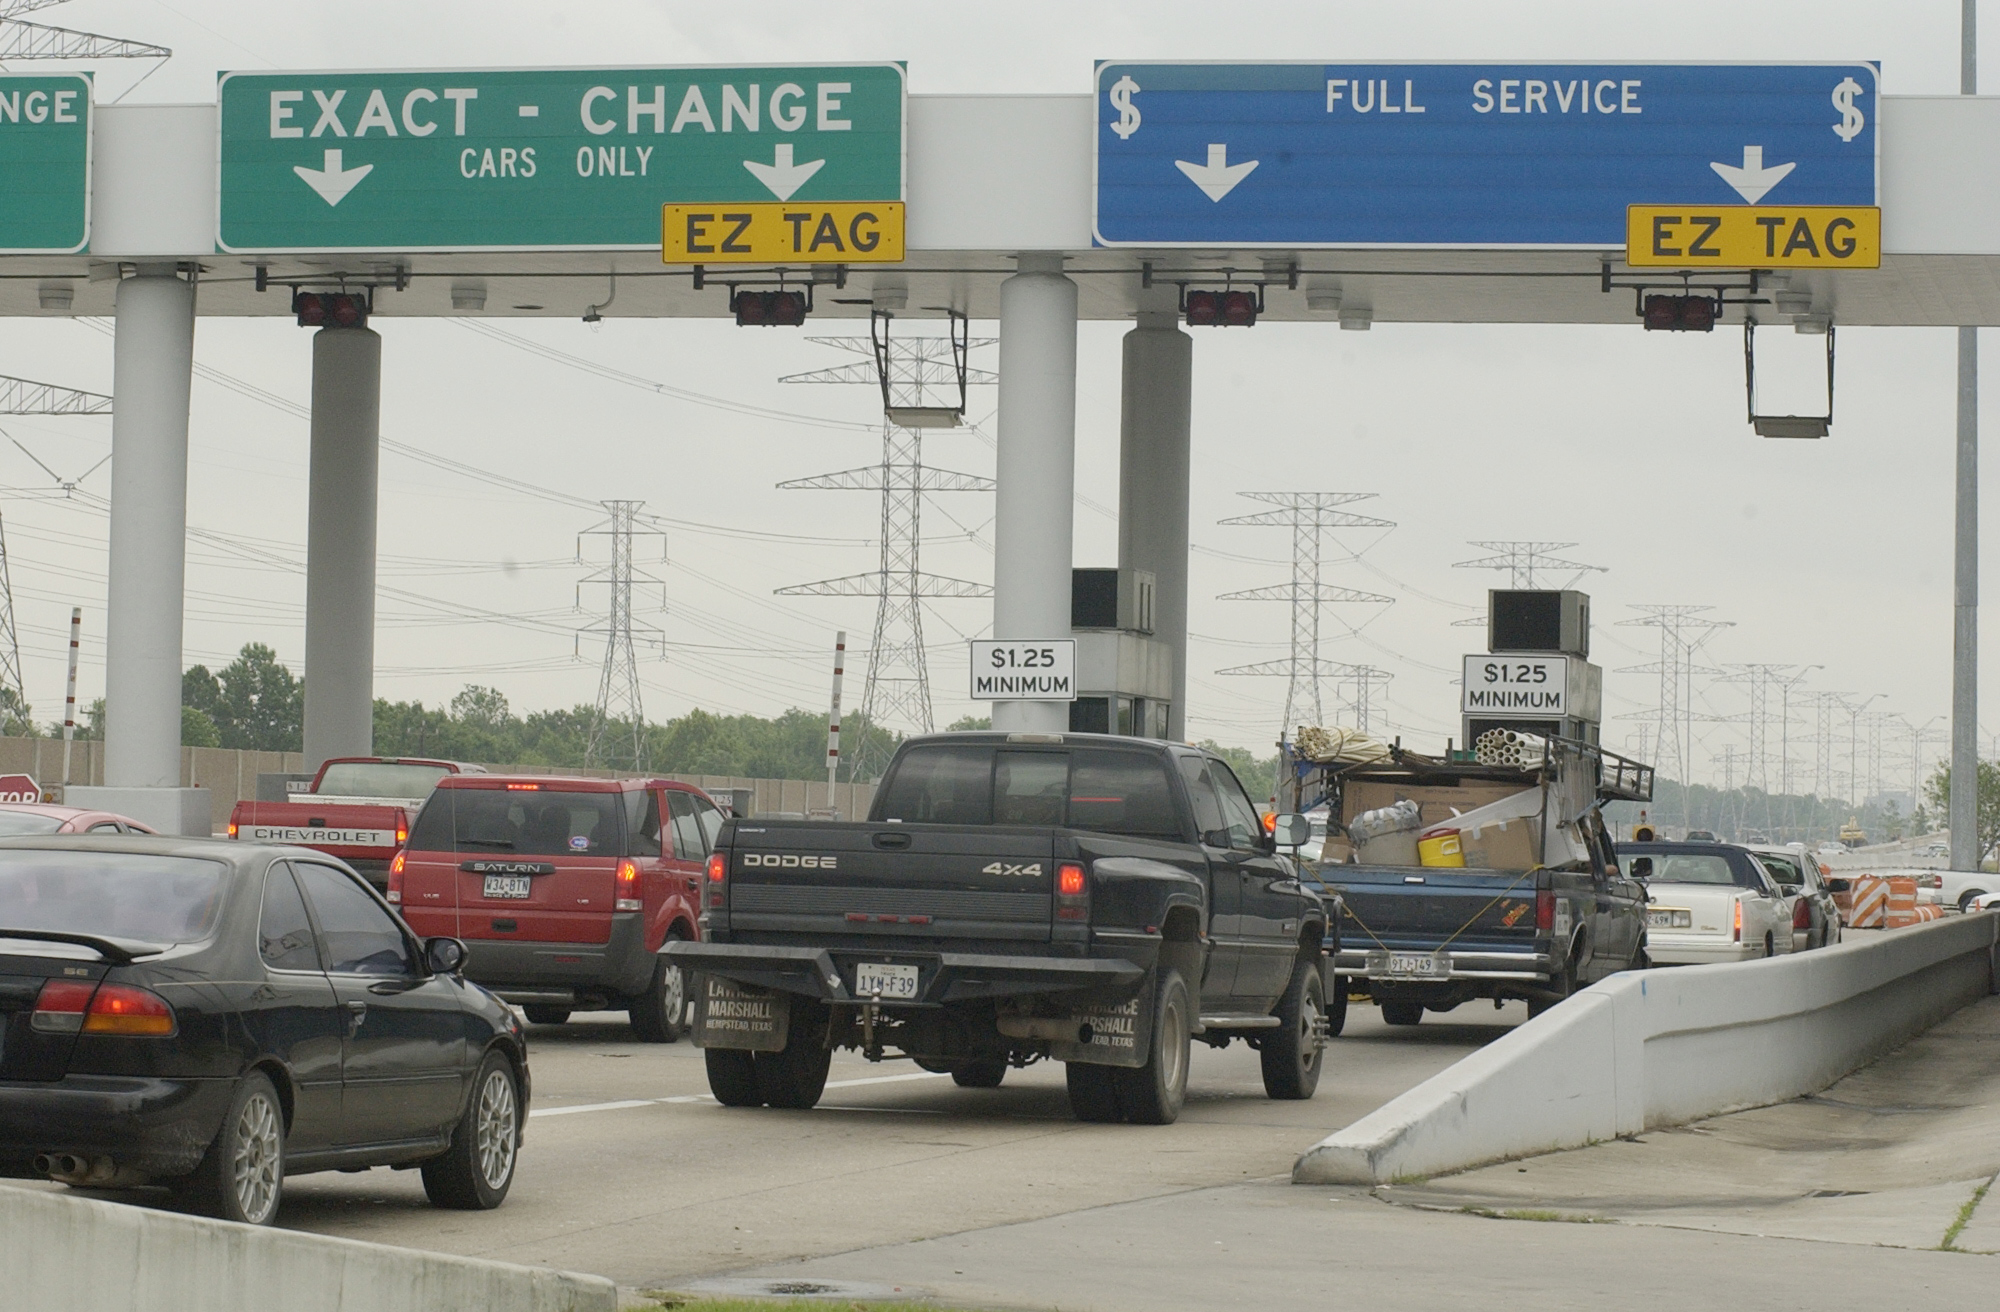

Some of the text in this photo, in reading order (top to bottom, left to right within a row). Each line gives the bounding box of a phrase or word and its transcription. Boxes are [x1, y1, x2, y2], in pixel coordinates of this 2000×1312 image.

[1110, 76, 1141, 139] $
[1326, 80, 1642, 114] FULL SERVICE
[271, 89, 478, 138] EXACT
[581, 83, 852, 134] CHANGE
[1832, 78, 1864, 142] $
[460, 147, 653, 178] CARS ONLY
[687, 212, 880, 253] EZ TAG
[1653, 216, 1857, 258] EZ TAG
[991, 647, 1055, 669] $1.25
[1484, 662, 1547, 684] $1.25
[977, 676, 1069, 693] MINIMUM
[1469, 691, 1560, 708] MINIMUM
[713, 795, 732, 805] 1.25
[255, 828, 380, 843] CHEVROLET
[474, 863, 540, 873] SATURN
[743, 854, 837, 869] DODGE
[709, 1000, 772, 1018] MARSHALL
[751, 1021, 773, 1031] TEXAS
